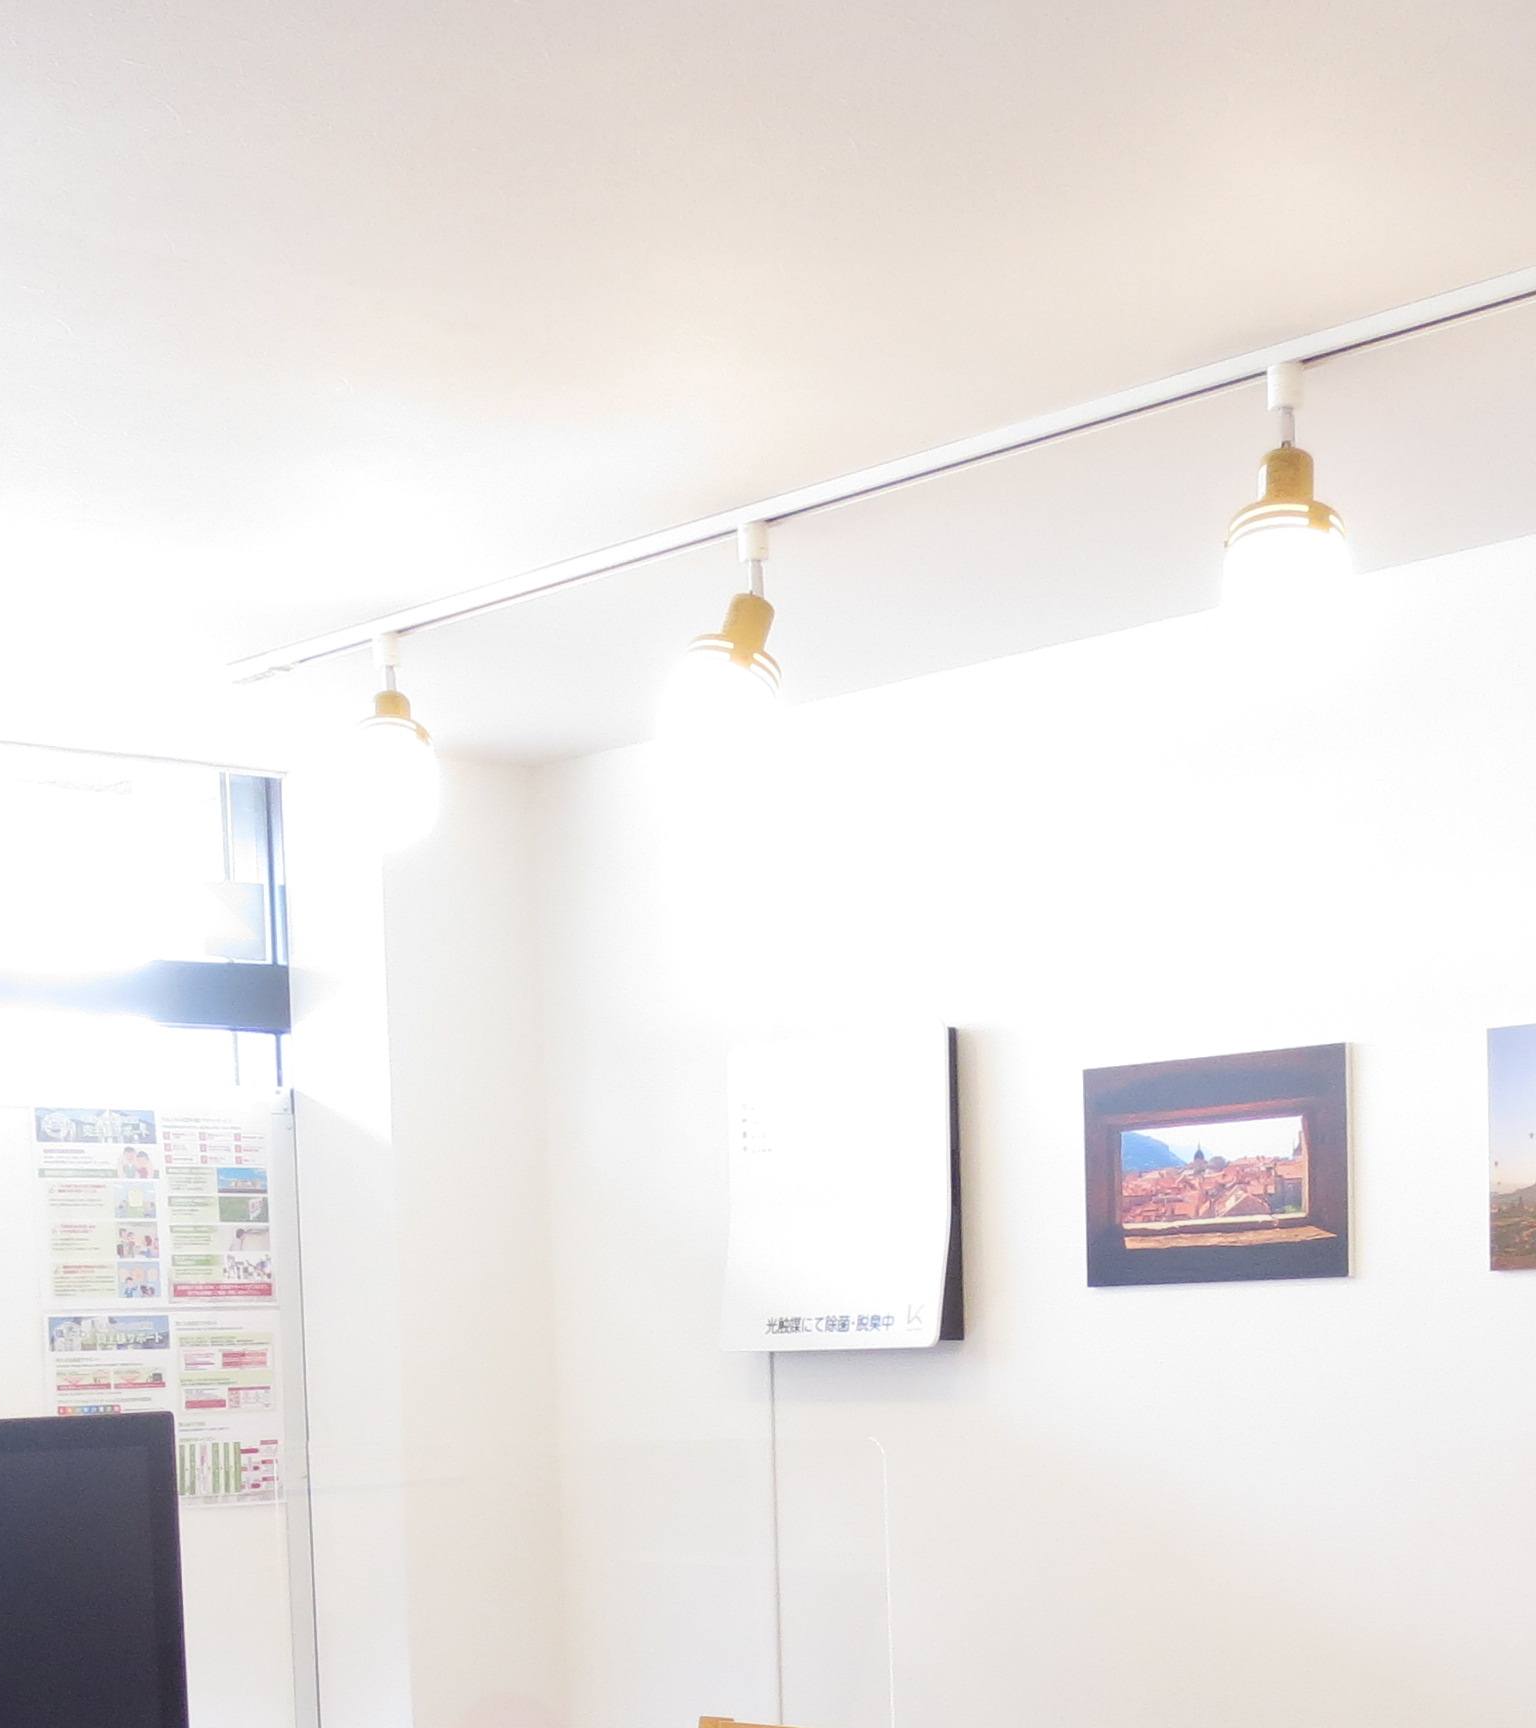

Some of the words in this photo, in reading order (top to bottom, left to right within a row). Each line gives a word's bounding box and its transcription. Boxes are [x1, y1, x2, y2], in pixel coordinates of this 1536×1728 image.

[765, 1315, 895, 1334] 光触媒にて除菌・脱臭中
